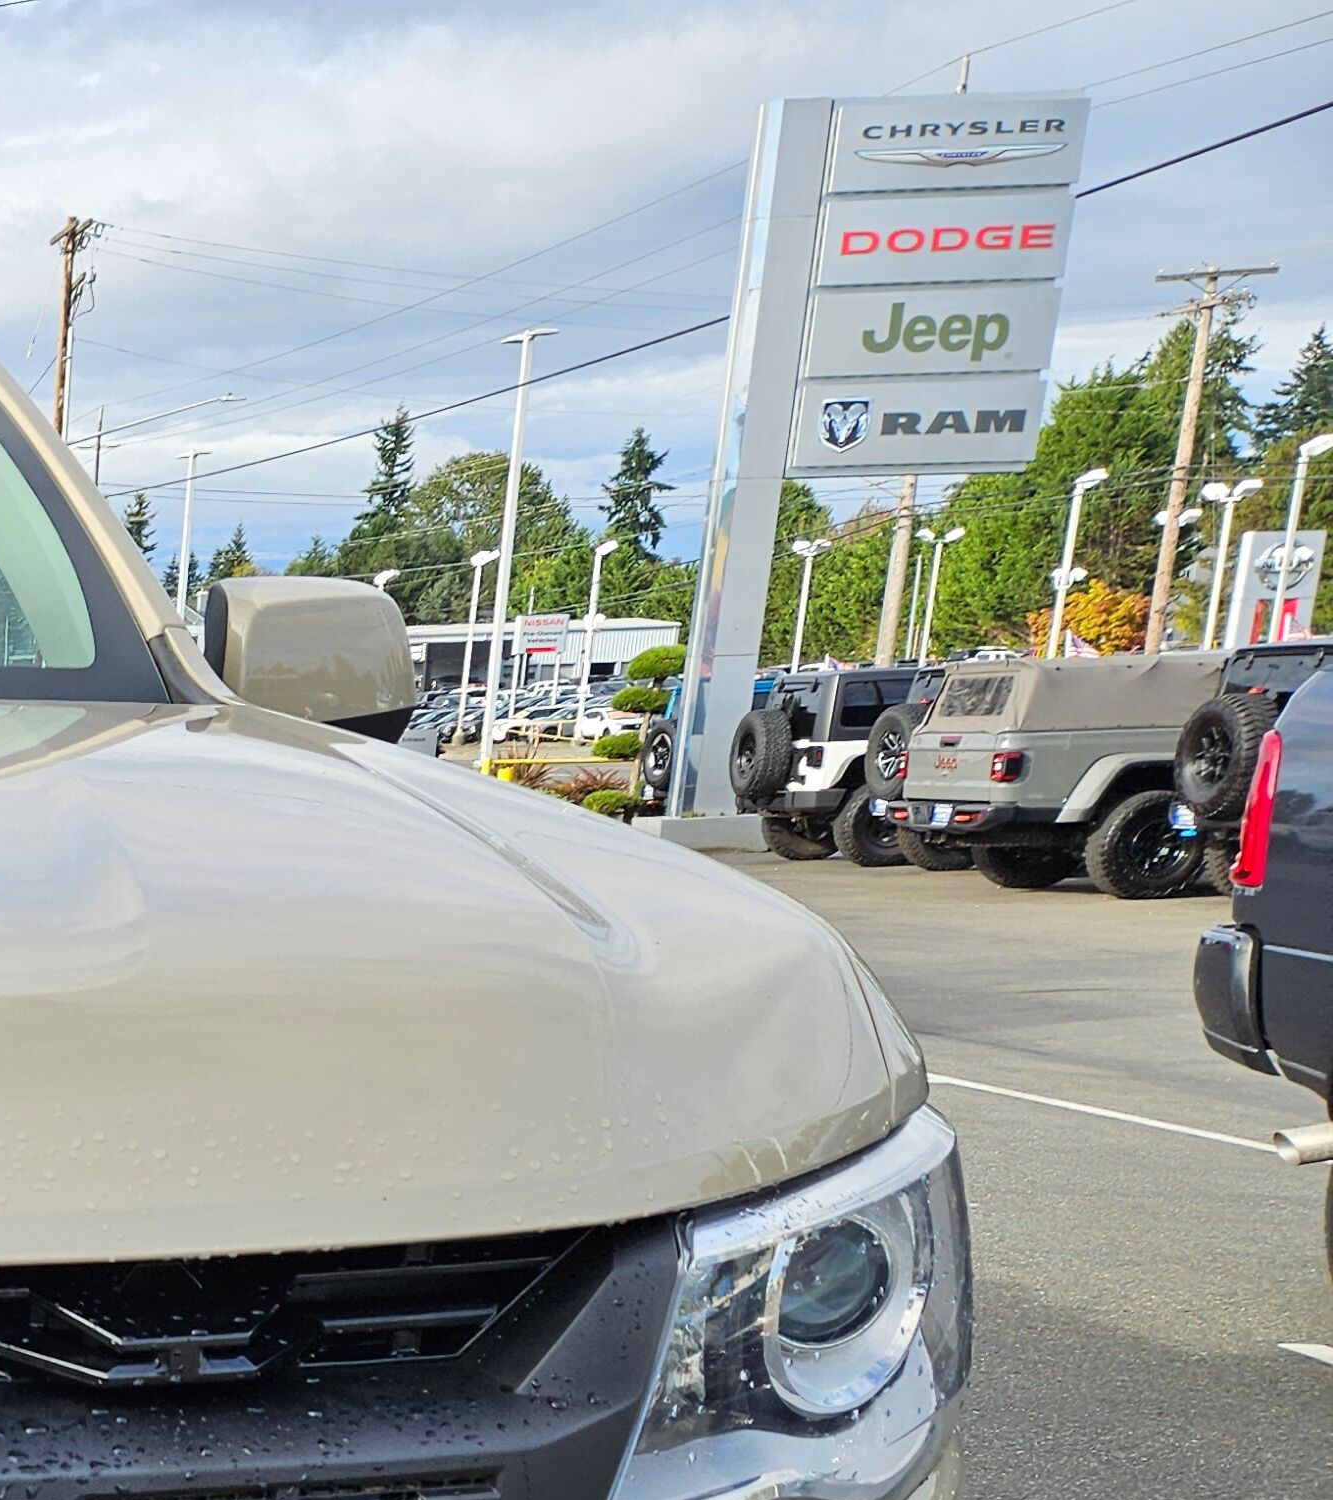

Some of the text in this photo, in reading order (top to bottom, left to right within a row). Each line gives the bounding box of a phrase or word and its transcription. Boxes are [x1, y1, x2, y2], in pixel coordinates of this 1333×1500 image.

[862, 118, 1066, 140] CHRYSLER
[840, 223, 1056, 256] DODGE
[862, 302, 1010, 362] Jeep
[880, 408, 1027, 436] RAM
[523, 617, 565, 627] NISSAN
